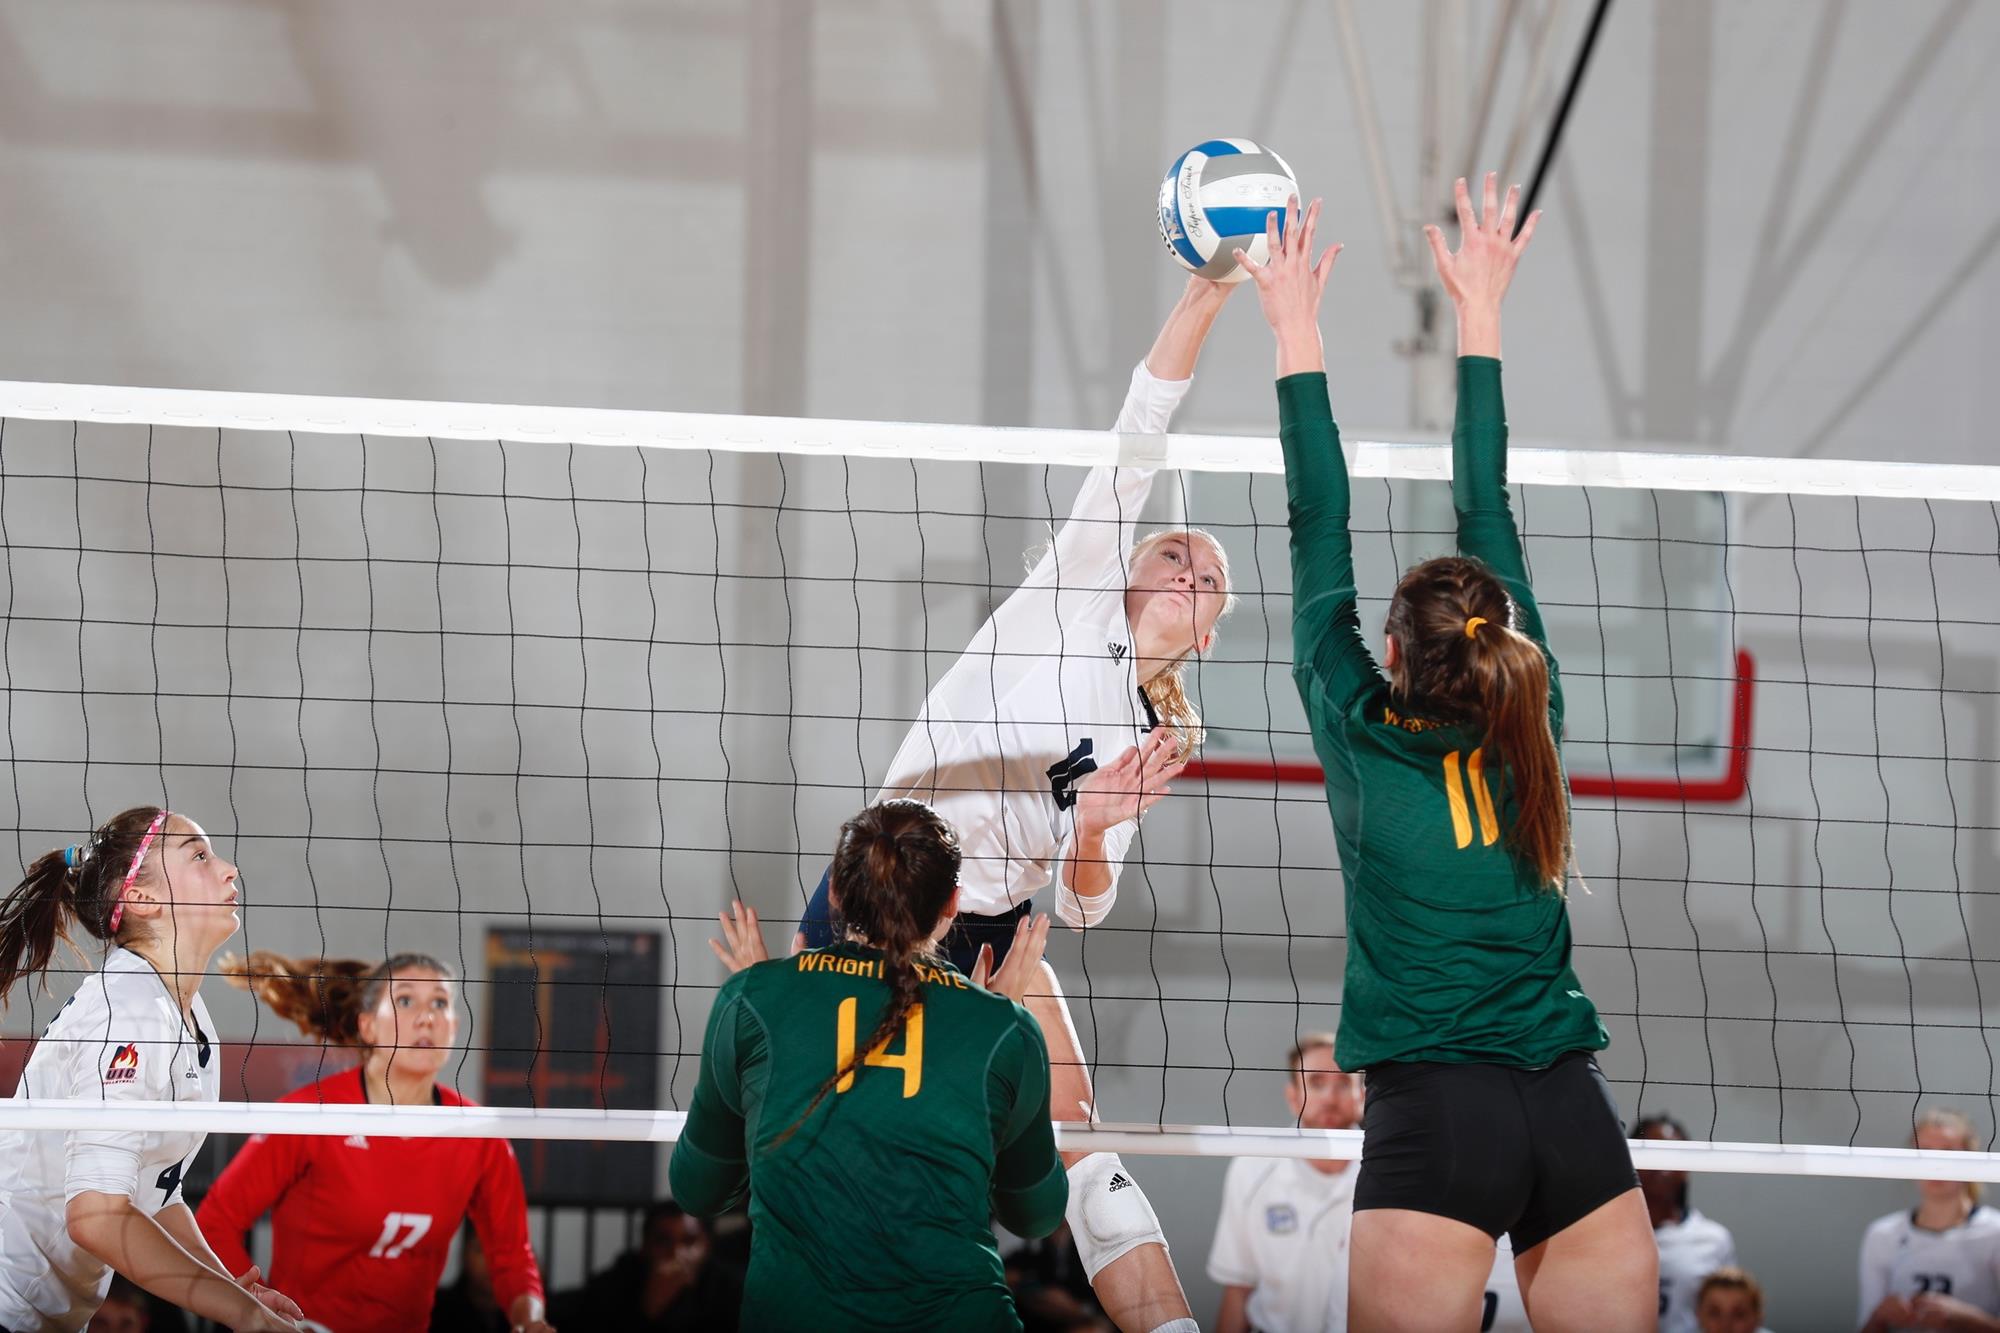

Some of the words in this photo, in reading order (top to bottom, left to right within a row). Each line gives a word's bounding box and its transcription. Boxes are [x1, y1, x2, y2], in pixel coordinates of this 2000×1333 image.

[1443, 747, 1500, 849] 11
[909, 962, 968, 989] TATE
[836, 997, 924, 1099] 14
[105, 1067, 137, 1080] UIC
[369, 1212, 433, 1259] 17
